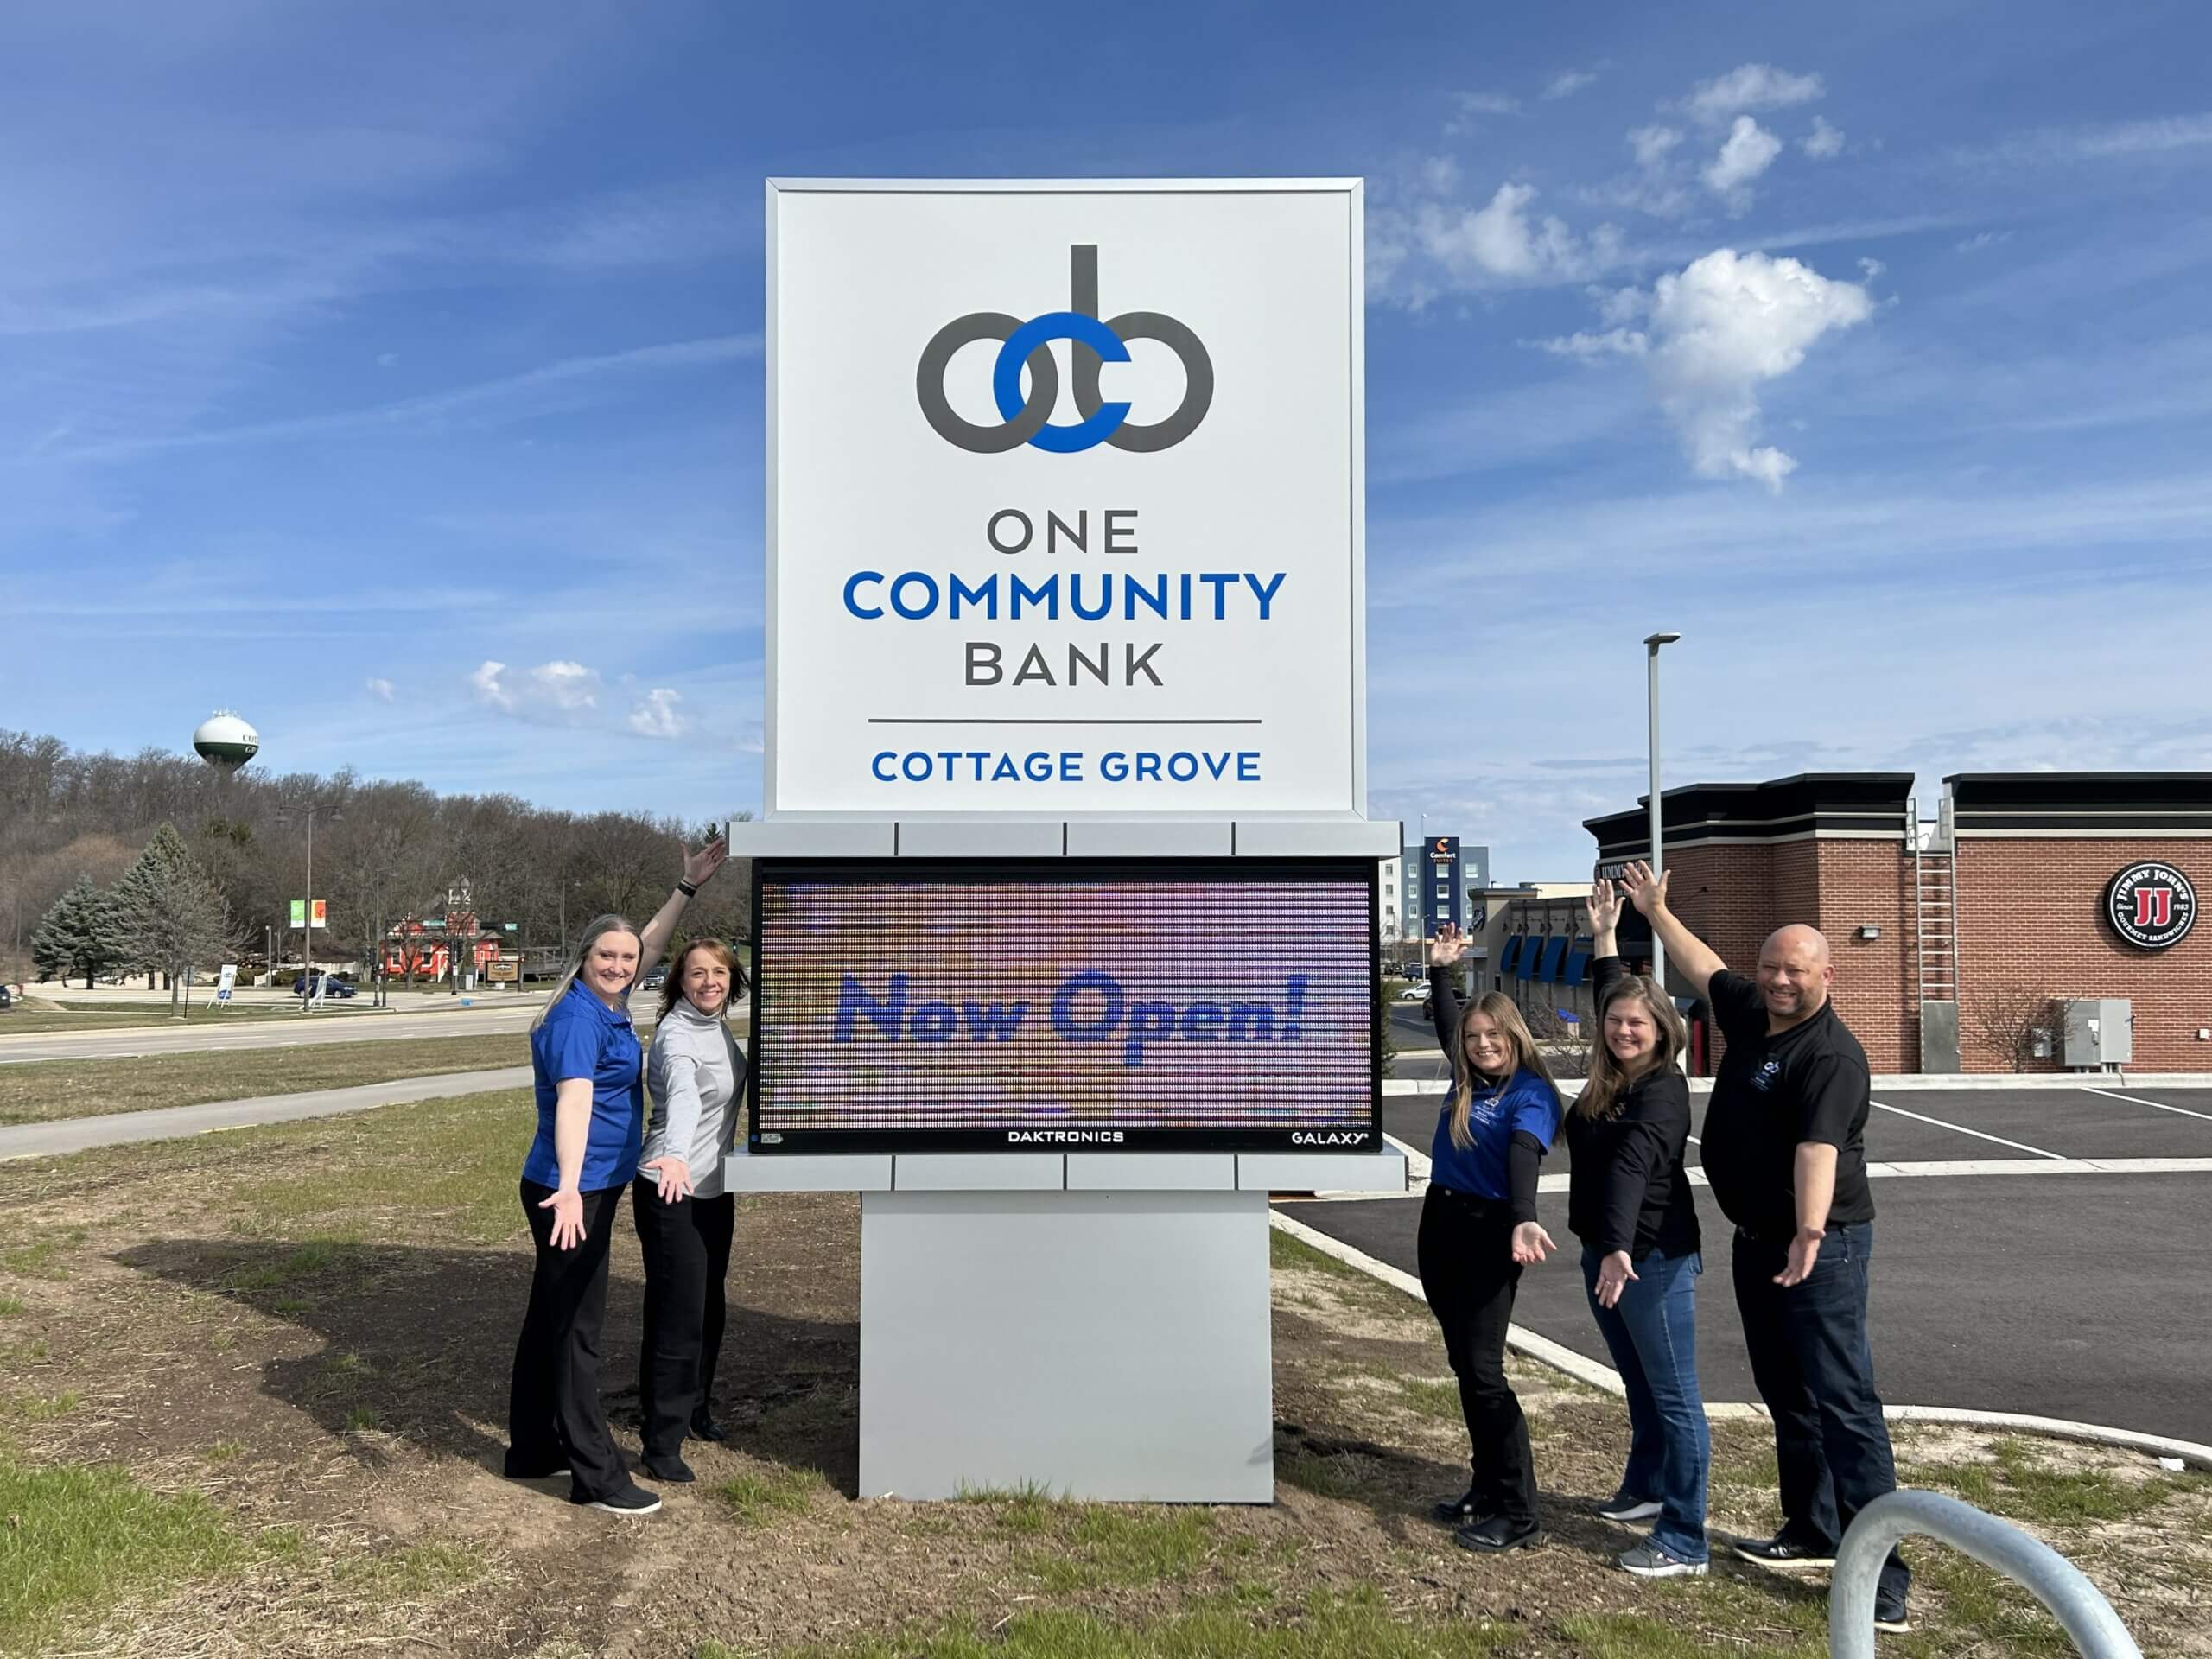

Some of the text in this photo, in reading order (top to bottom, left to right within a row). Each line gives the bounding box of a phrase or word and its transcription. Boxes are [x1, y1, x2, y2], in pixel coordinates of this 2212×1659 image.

[987, 508, 1138, 555] ONE
[842, 570, 1287, 621] COMMUNITY
[965, 642, 1164, 686] BANK
[871, 751, 1261, 782] COTTAGE GROVE
[2117, 869, 2190, 901] JIMMY JOHN'S
[2117, 912, 2190, 942] GOURMET SANDWICHES
[2134, 887, 2173, 927] JJ
[836, 969, 1309, 1067] Now Open!
[1007, 1131, 1124, 1143] DAKTRONICS
